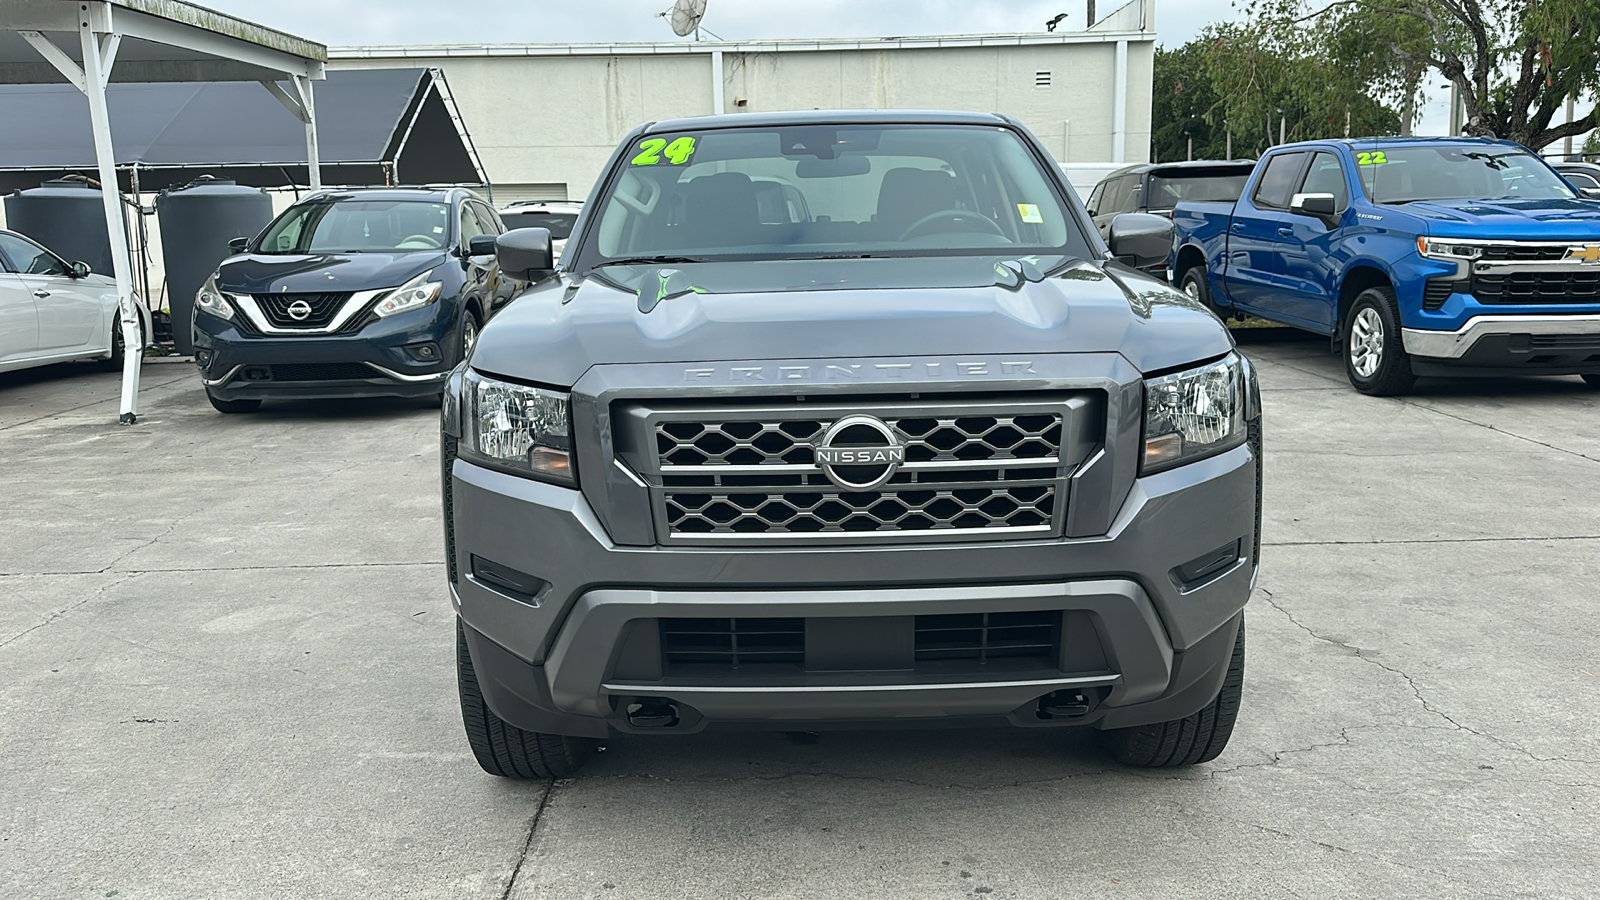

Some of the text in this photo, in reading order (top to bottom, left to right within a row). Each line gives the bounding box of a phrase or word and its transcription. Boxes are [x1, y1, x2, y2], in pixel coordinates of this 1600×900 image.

[631, 136, 696, 166] 24
[1356, 151, 1388, 165] 22
[683, 361, 1038, 382] FRONTIER
[817, 449, 902, 463] NISSAN
